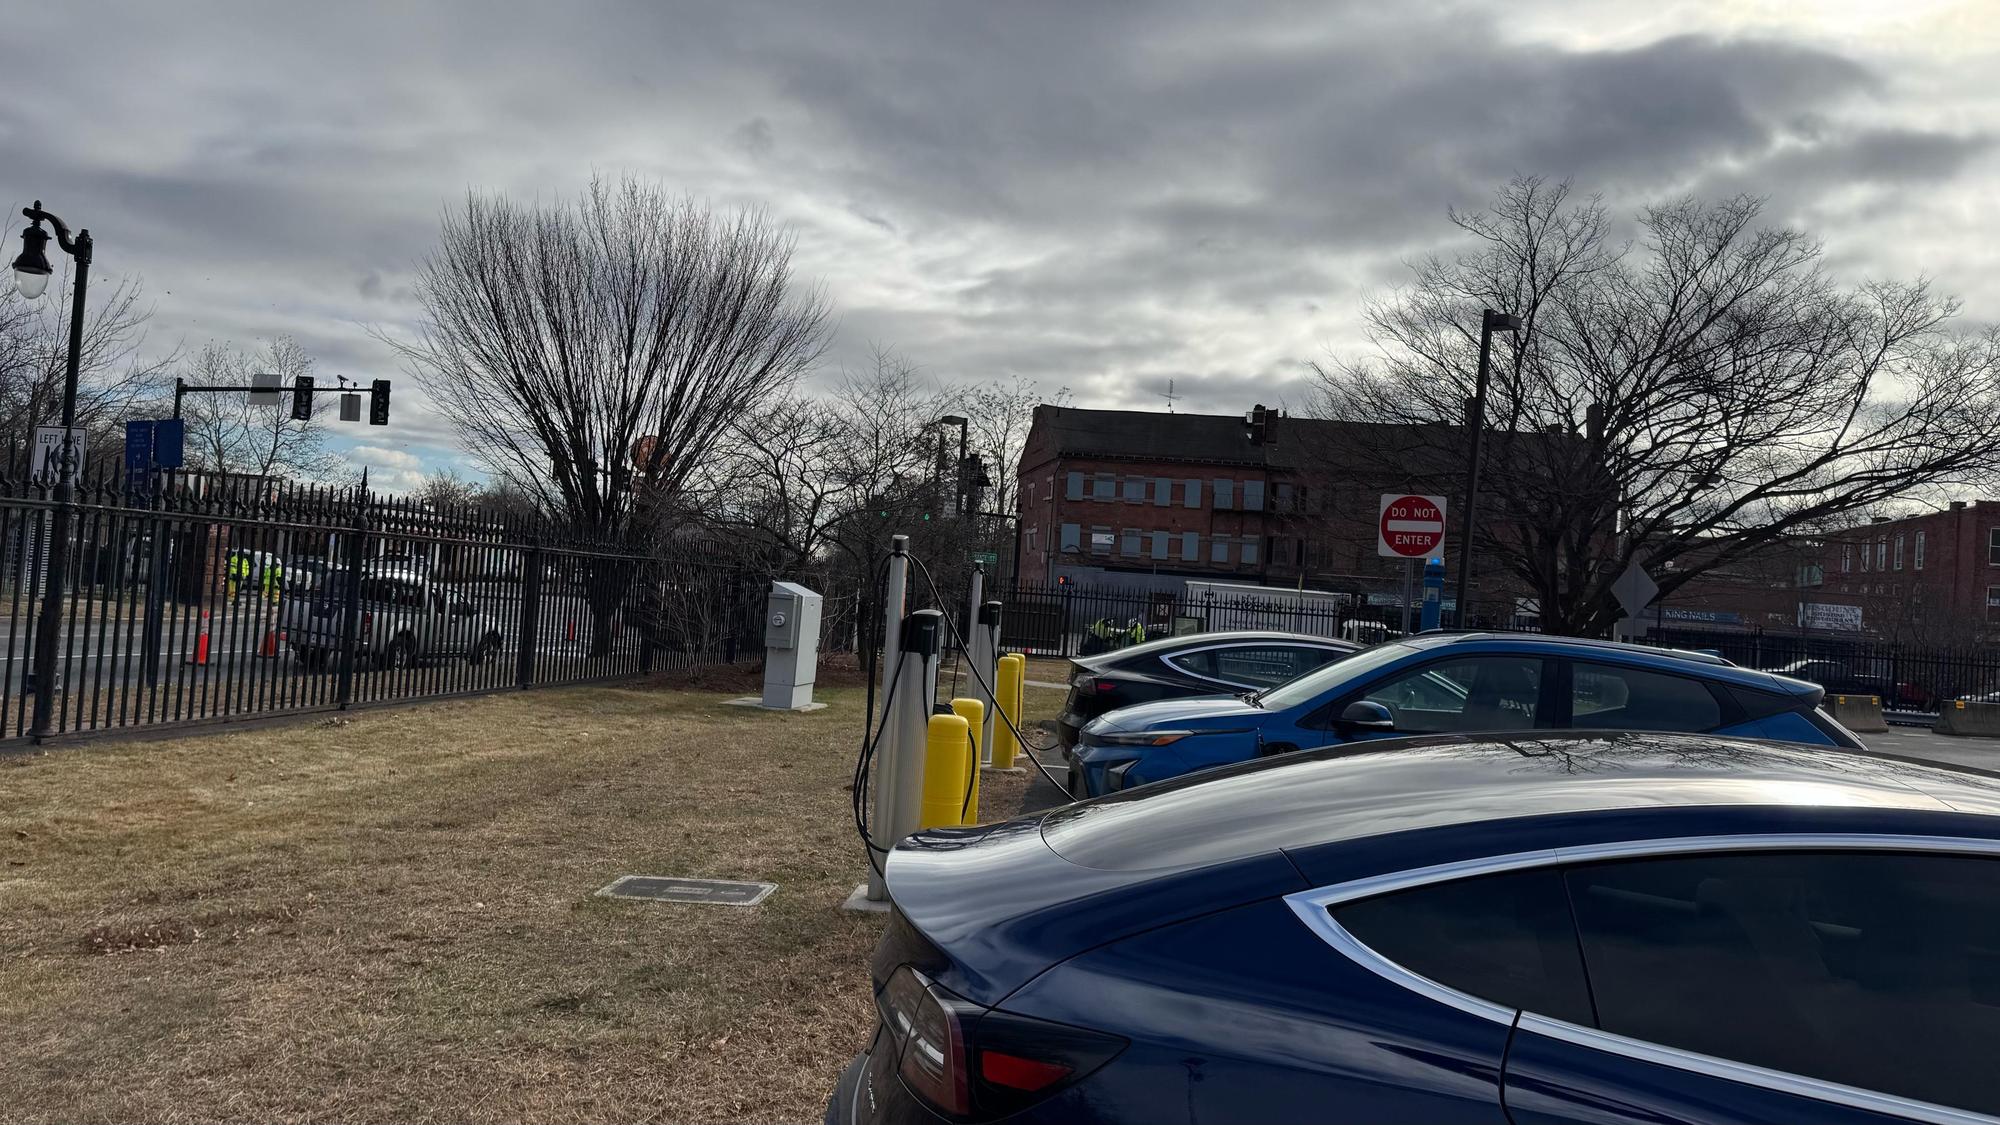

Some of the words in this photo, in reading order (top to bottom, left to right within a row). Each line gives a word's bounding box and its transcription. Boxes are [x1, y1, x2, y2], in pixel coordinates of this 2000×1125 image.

[39, 434, 58, 444] LEFT
[61, 434, 81, 445] LNE
[1391, 507, 1407, 517] DO
[1414, 508, 1436, 518] NOT
[1395, 534, 1432, 545] ENTER
[1665, 609, 1687, 619] KING
[1689, 611, 1716, 621] NAILS
